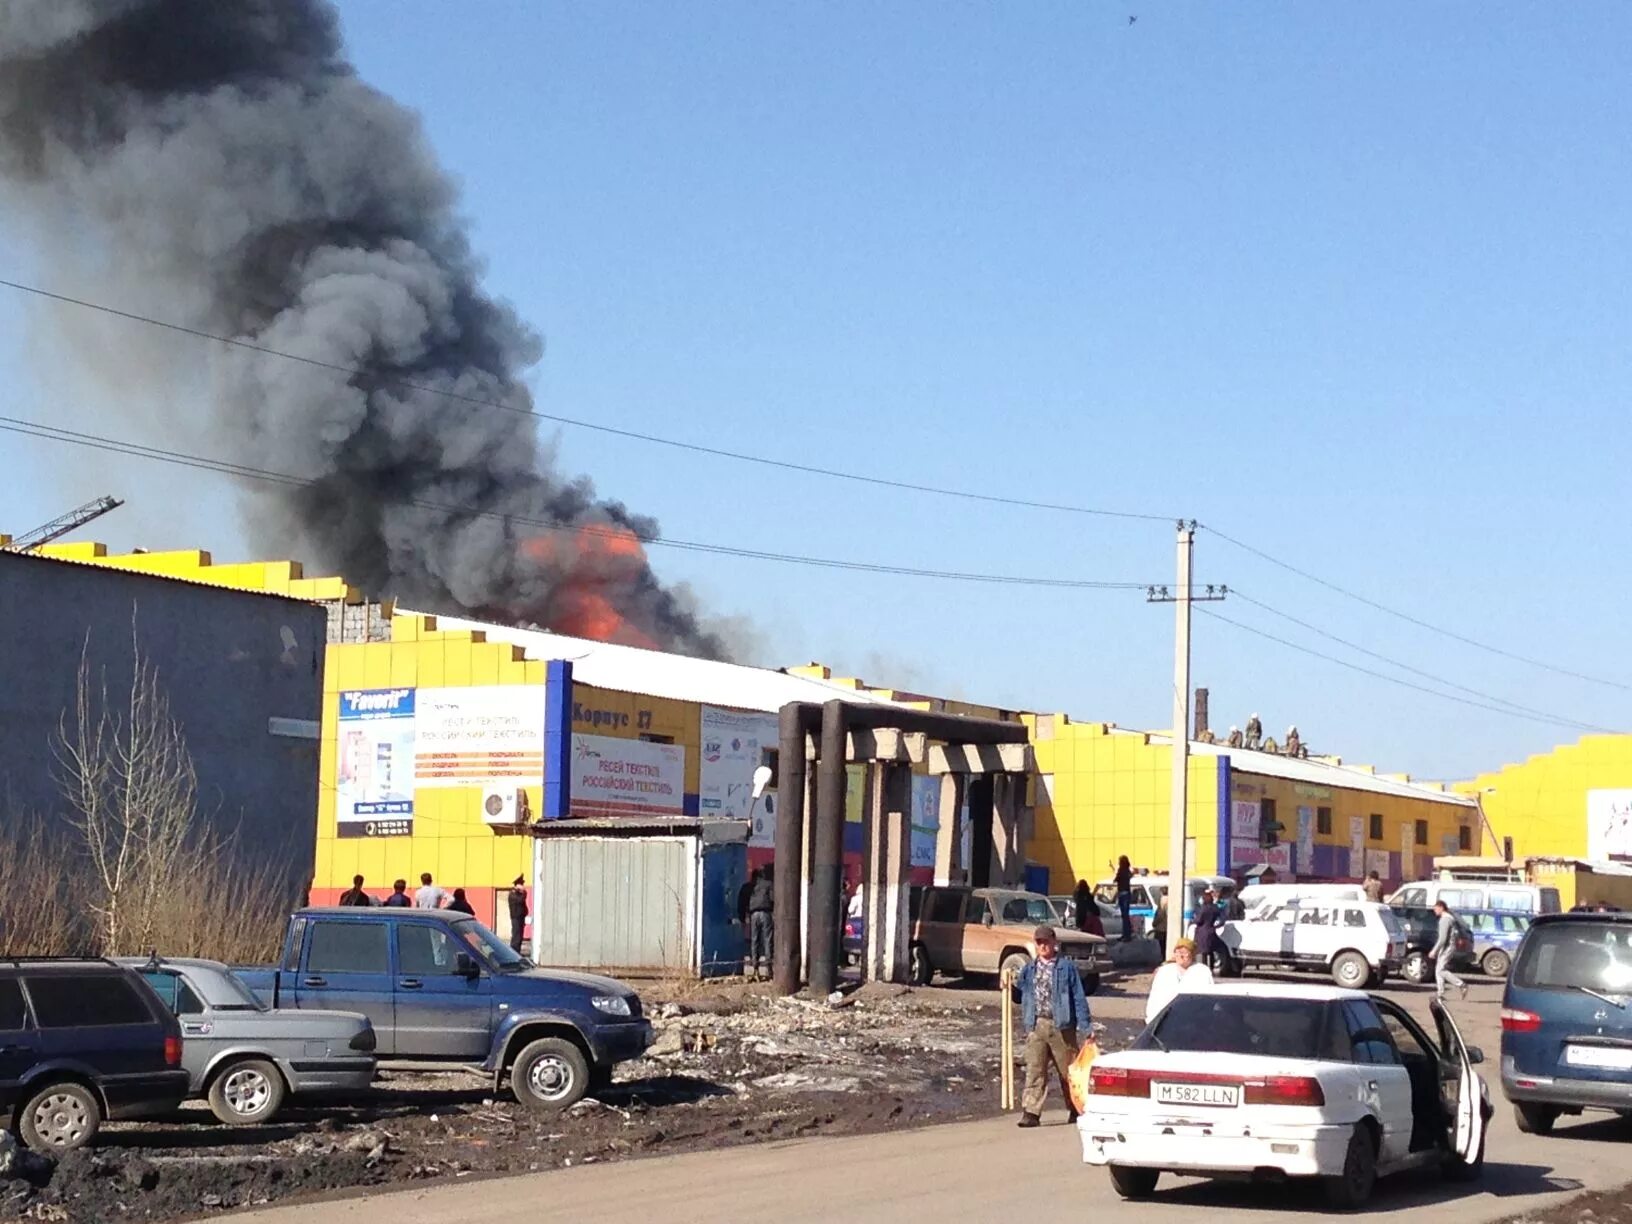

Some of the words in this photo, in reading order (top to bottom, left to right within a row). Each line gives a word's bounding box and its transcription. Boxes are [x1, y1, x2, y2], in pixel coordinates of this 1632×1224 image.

[573, 703, 629, 730] Корпус
[582, 775, 635, 791] РОССИЙСКИЙ
[635, 781, 673, 795] ТЕКСТИЛЬ
[1162, 1086, 1172, 1099] M
[1176, 1087, 1200, 1102] 582
[1204, 1089, 1233, 1104] LLN
